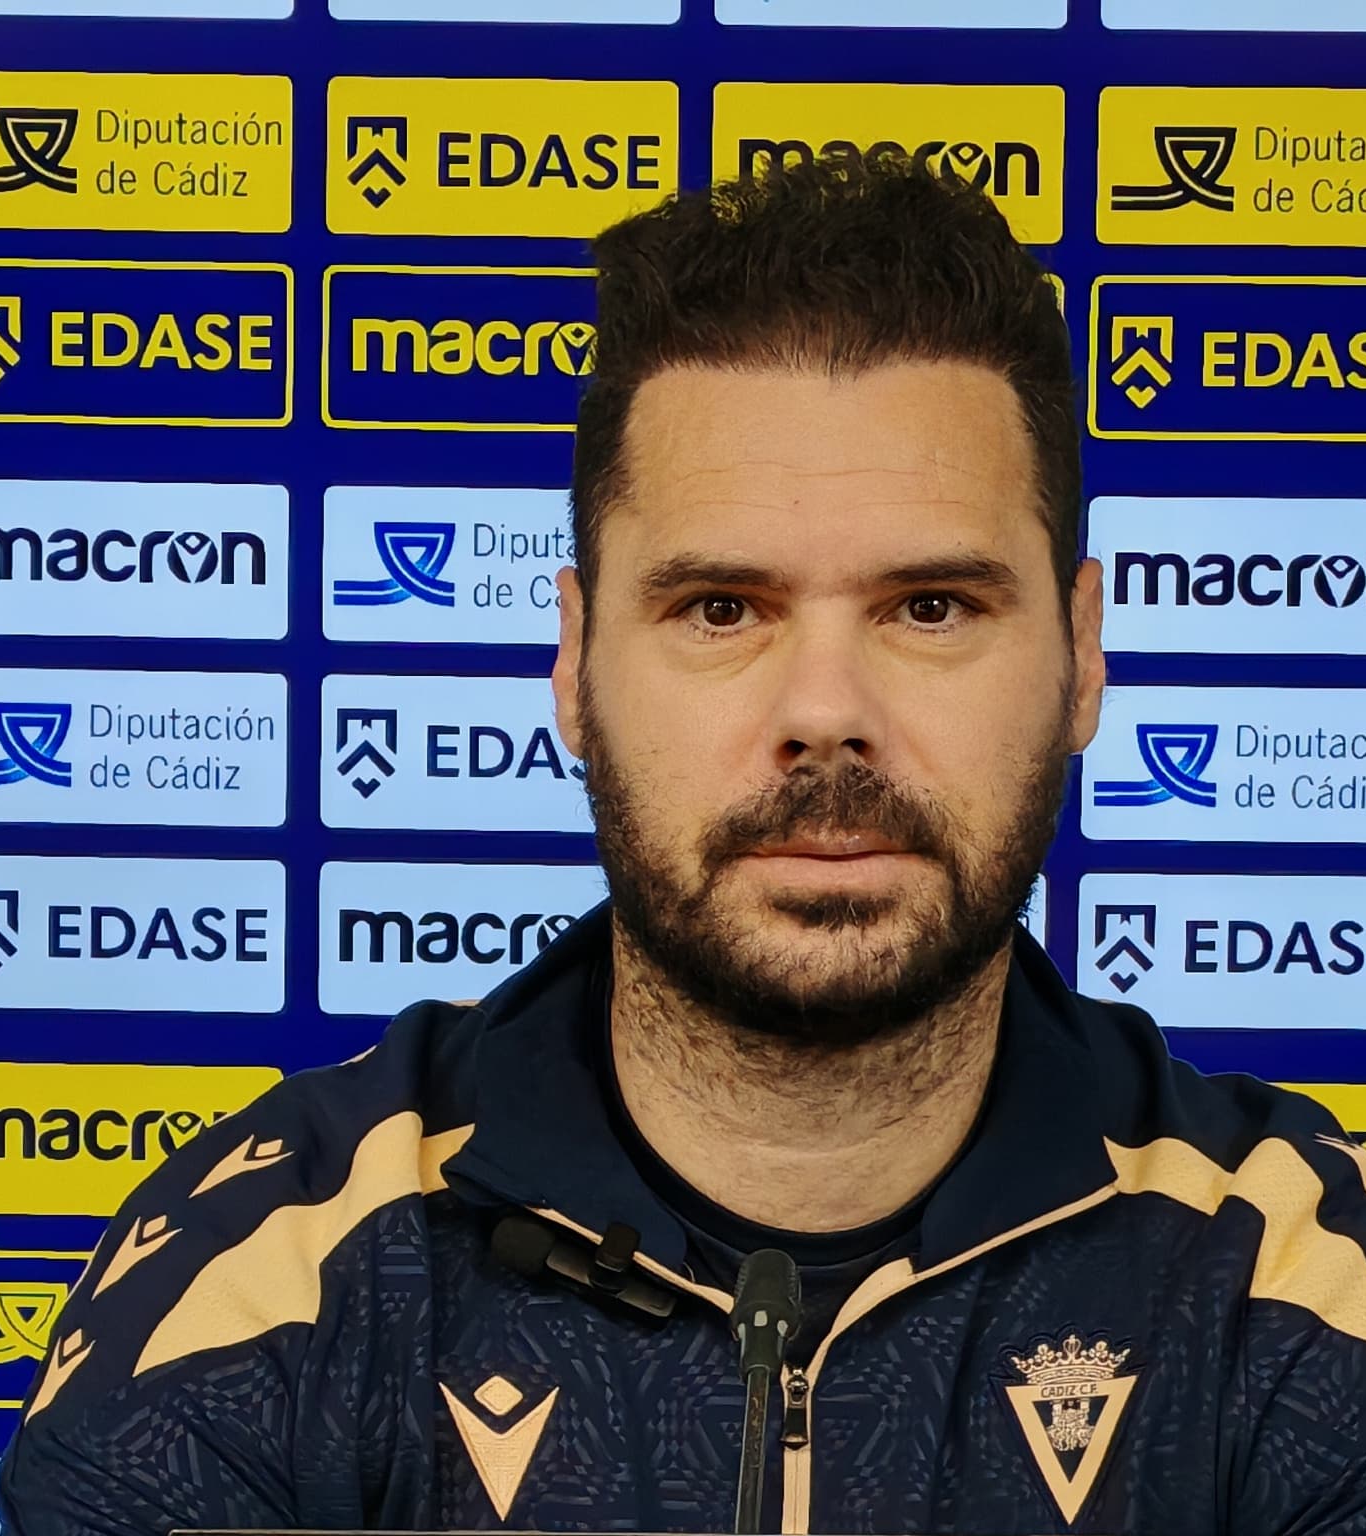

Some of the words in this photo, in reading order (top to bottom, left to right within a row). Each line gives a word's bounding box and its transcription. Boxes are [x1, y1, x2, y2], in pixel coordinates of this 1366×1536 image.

[96, 109, 282, 150] Diputación
[95, 160, 137, 195] de
[153, 161, 248, 197] Cádiz
[437, 131, 661, 191] EDASE
[1253, 178, 1294, 213] de
[51, 311, 273, 371] EDASE
[352, 318, 599, 378] macro
[473, 523, 579, 565] Diput
[473, 574, 513, 609] de
[89, 703, 274, 745] Diputación
[89, 754, 131, 789] de
[146, 755, 241, 790] Cádiz
[426, 724, 587, 782] EDA
[1234, 774, 1276, 809] de
[48, 905, 268, 962] EDASE
[338, 909, 568, 966] macr
